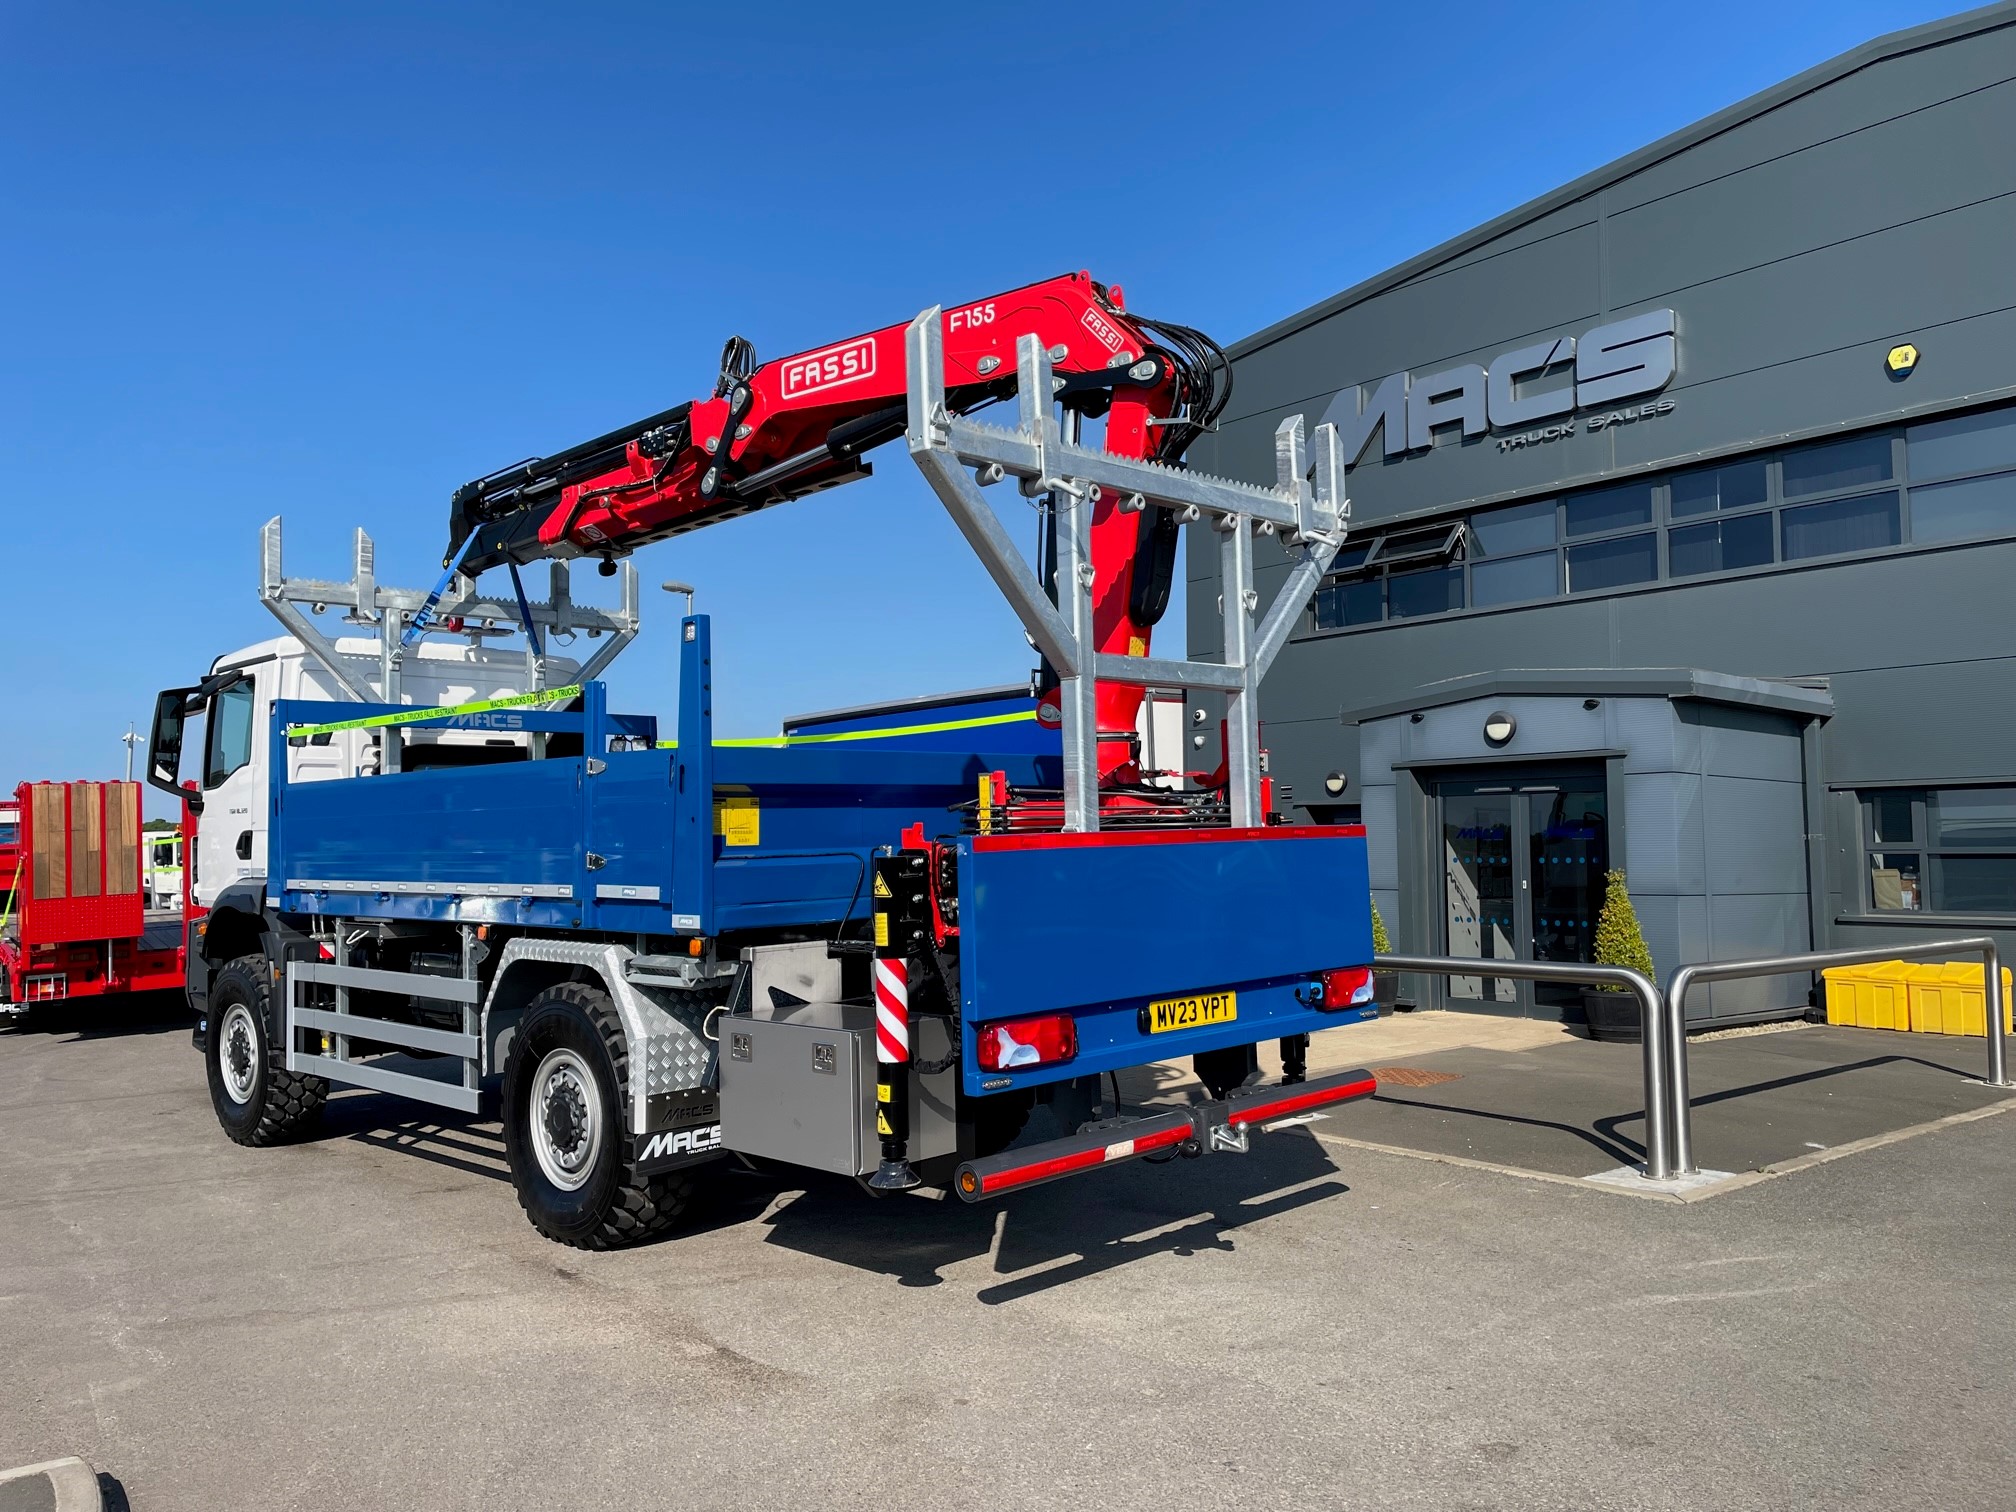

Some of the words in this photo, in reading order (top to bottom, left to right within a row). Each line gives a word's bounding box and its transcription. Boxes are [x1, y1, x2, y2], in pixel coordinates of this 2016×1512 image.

[950, 303, 995, 333] F155
[1085, 313, 1119, 347] FASSI
[789, 347, 867, 390] FASSI
[1498, 421, 1576, 449] TRUCK
[1588, 399, 1675, 428] SALES
[558, 686, 578, 697] TRUCKS
[1157, 1000, 1197, 1028] MV23
[1201, 995, 1229, 1020] YPT
[686, 1146, 708, 1155] TRUCK
